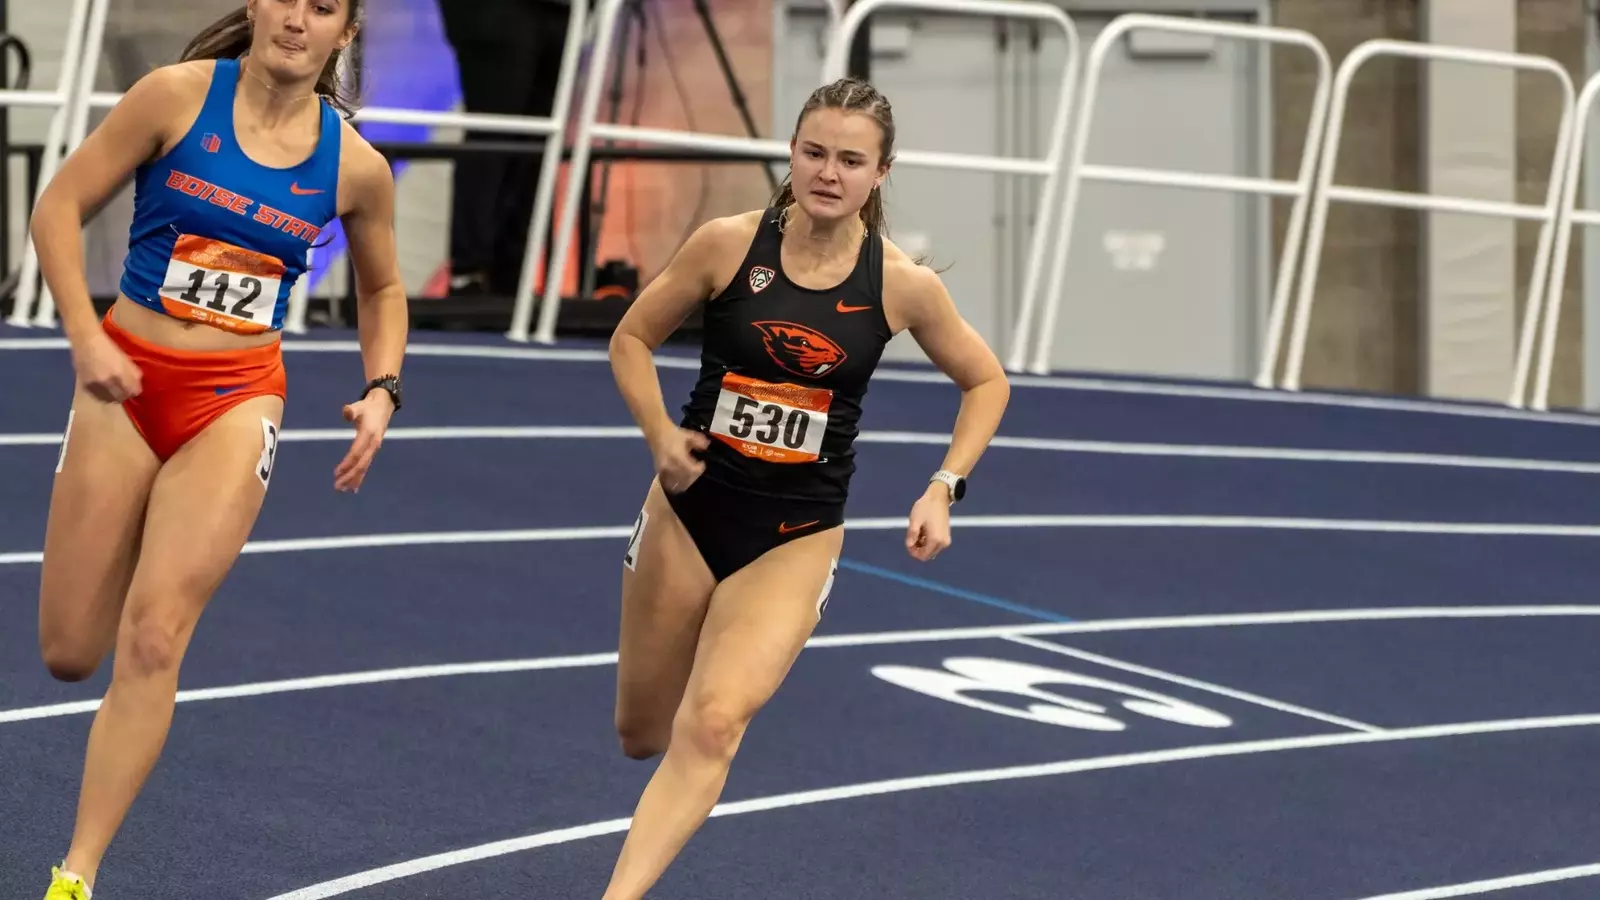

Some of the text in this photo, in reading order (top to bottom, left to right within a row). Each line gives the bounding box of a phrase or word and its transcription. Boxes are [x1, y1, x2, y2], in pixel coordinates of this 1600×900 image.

[165, 169, 253, 215] BOISE
[180, 269, 262, 319] 112
[751, 267, 774, 284] PAC
[752, 278, 765, 288] 12
[729, 396, 810, 450] 530
[260, 424, 277, 481] 3
[870, 656, 1233, 731] 3
